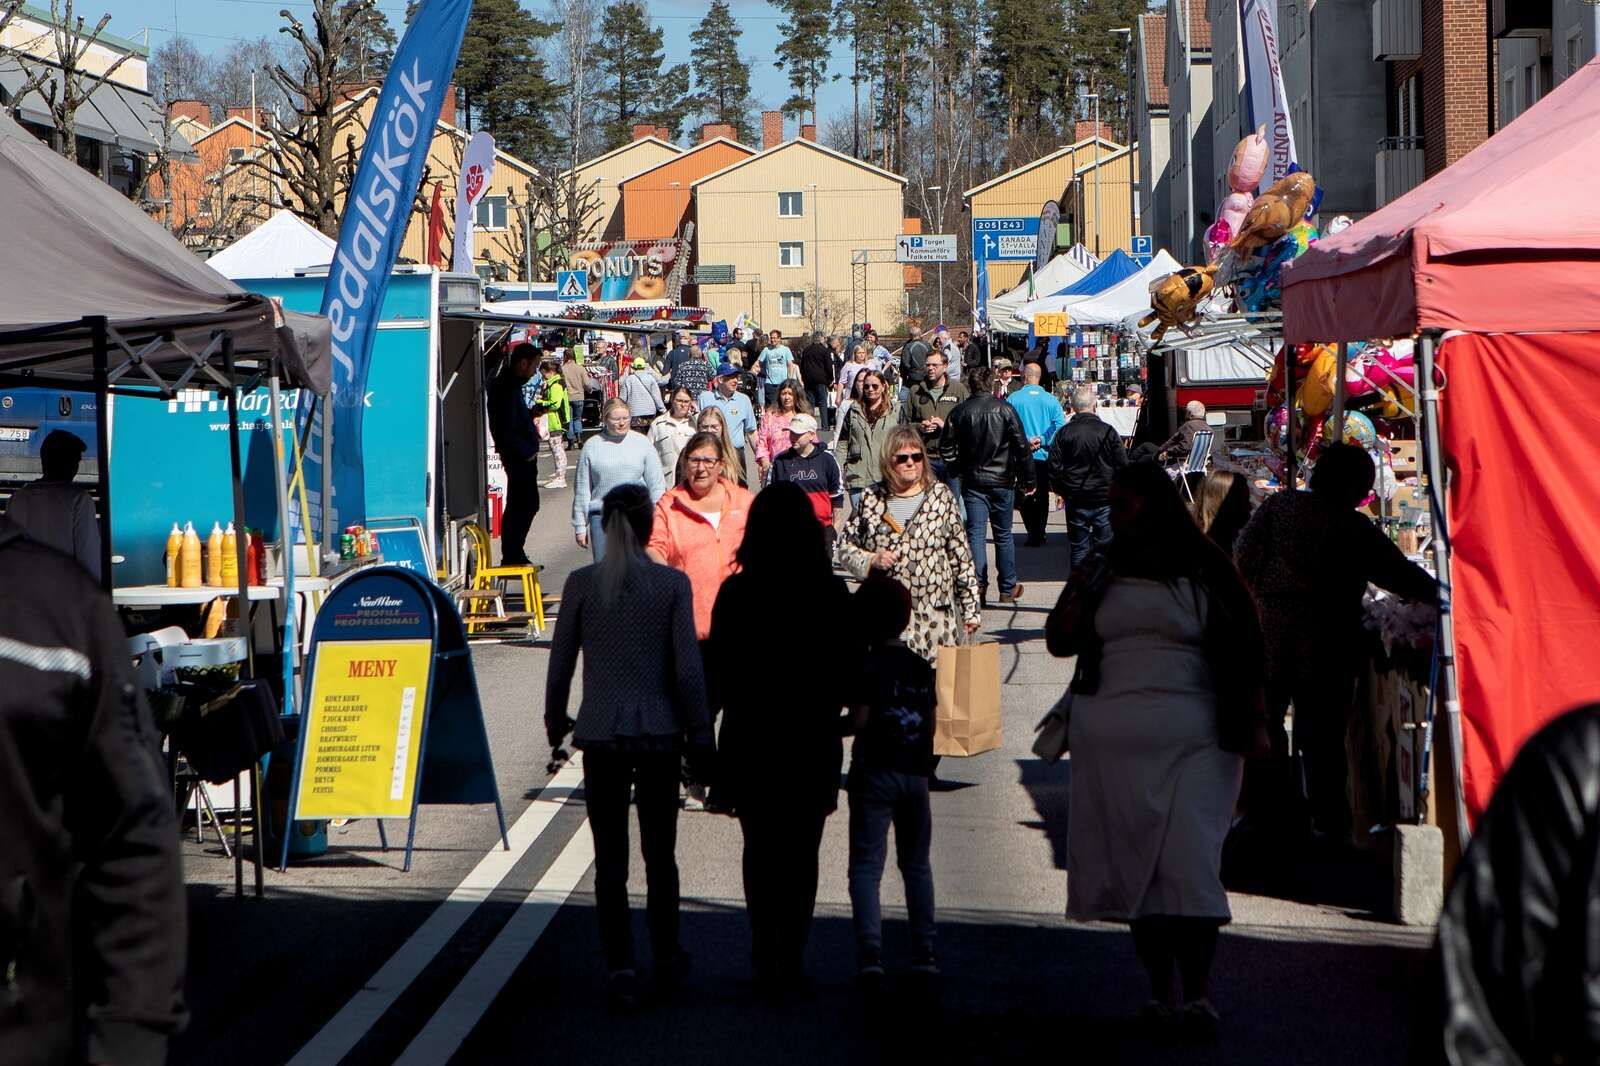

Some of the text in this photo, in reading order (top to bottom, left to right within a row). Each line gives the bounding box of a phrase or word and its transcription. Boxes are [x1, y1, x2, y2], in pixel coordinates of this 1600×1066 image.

[1273, 112, 1290, 185] KONFE
[1137, 239, 1147, 249] P
[576, 255, 664, 277] DONUTS
[1038, 315, 1065, 334] REA
[789, 468, 818, 482] FILA
[356, 609, 399, 617] PROFILE
[335, 617, 420, 626] PROFESSIONALS
[347, 660, 397, 678] MENY
